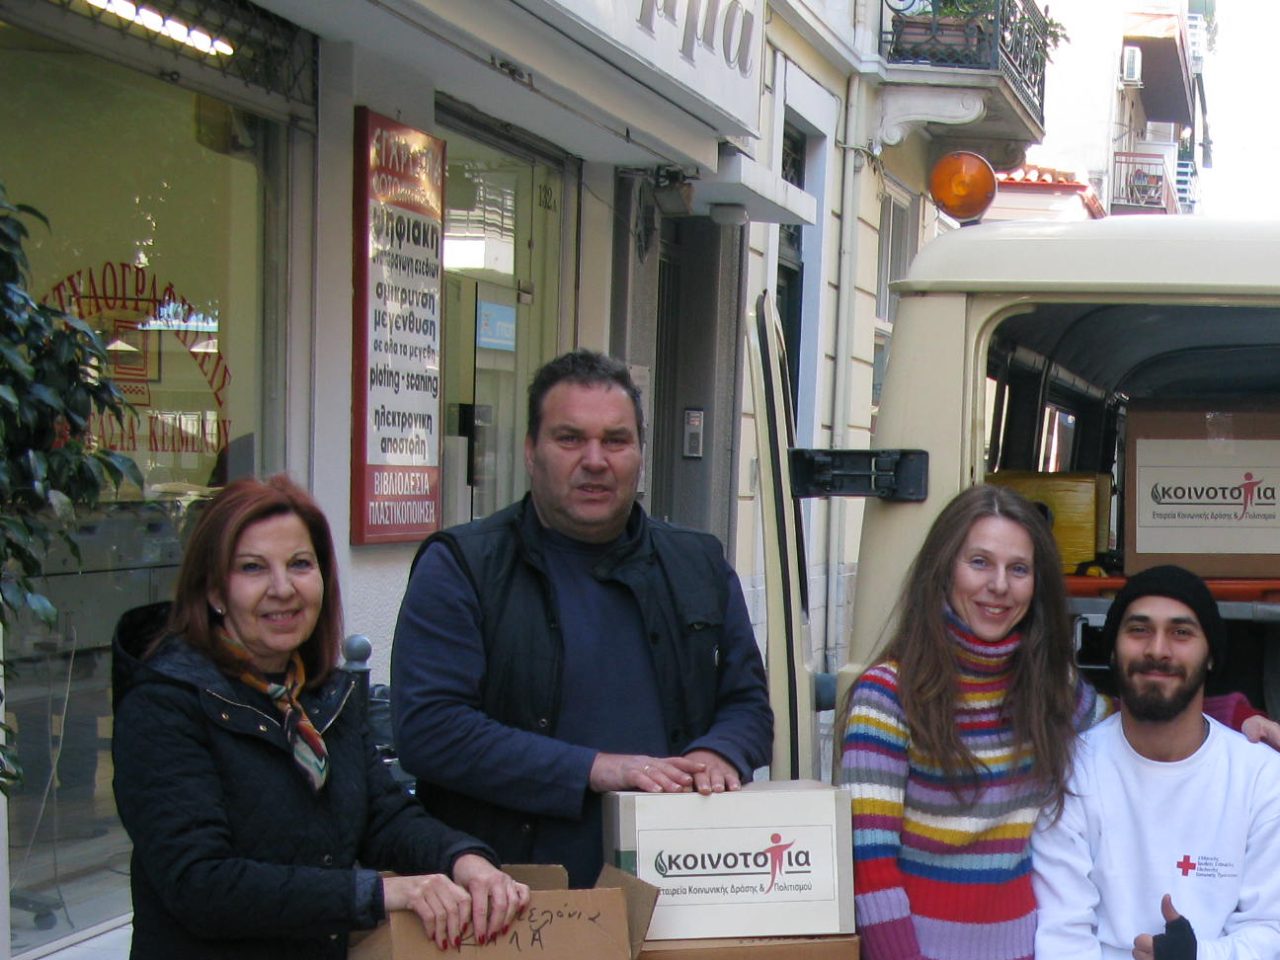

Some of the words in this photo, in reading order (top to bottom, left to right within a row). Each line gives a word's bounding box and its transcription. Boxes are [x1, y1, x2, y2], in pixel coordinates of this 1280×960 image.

[370, 363, 401, 395] ploting
[406, 369, 438, 399] scaning
[374, 471, 430, 496] ΒΙΒΛΙΟΔΕΣΙΑ
[369, 499, 436, 526] ΠΛΑΣΤΙΚΟΠΟΙΗΣΗ
[688, 886, 730, 896] Κοινωνικής
[730, 884, 757, 895] Δράσης
[773, 880, 812, 893] Πολιτισμού
